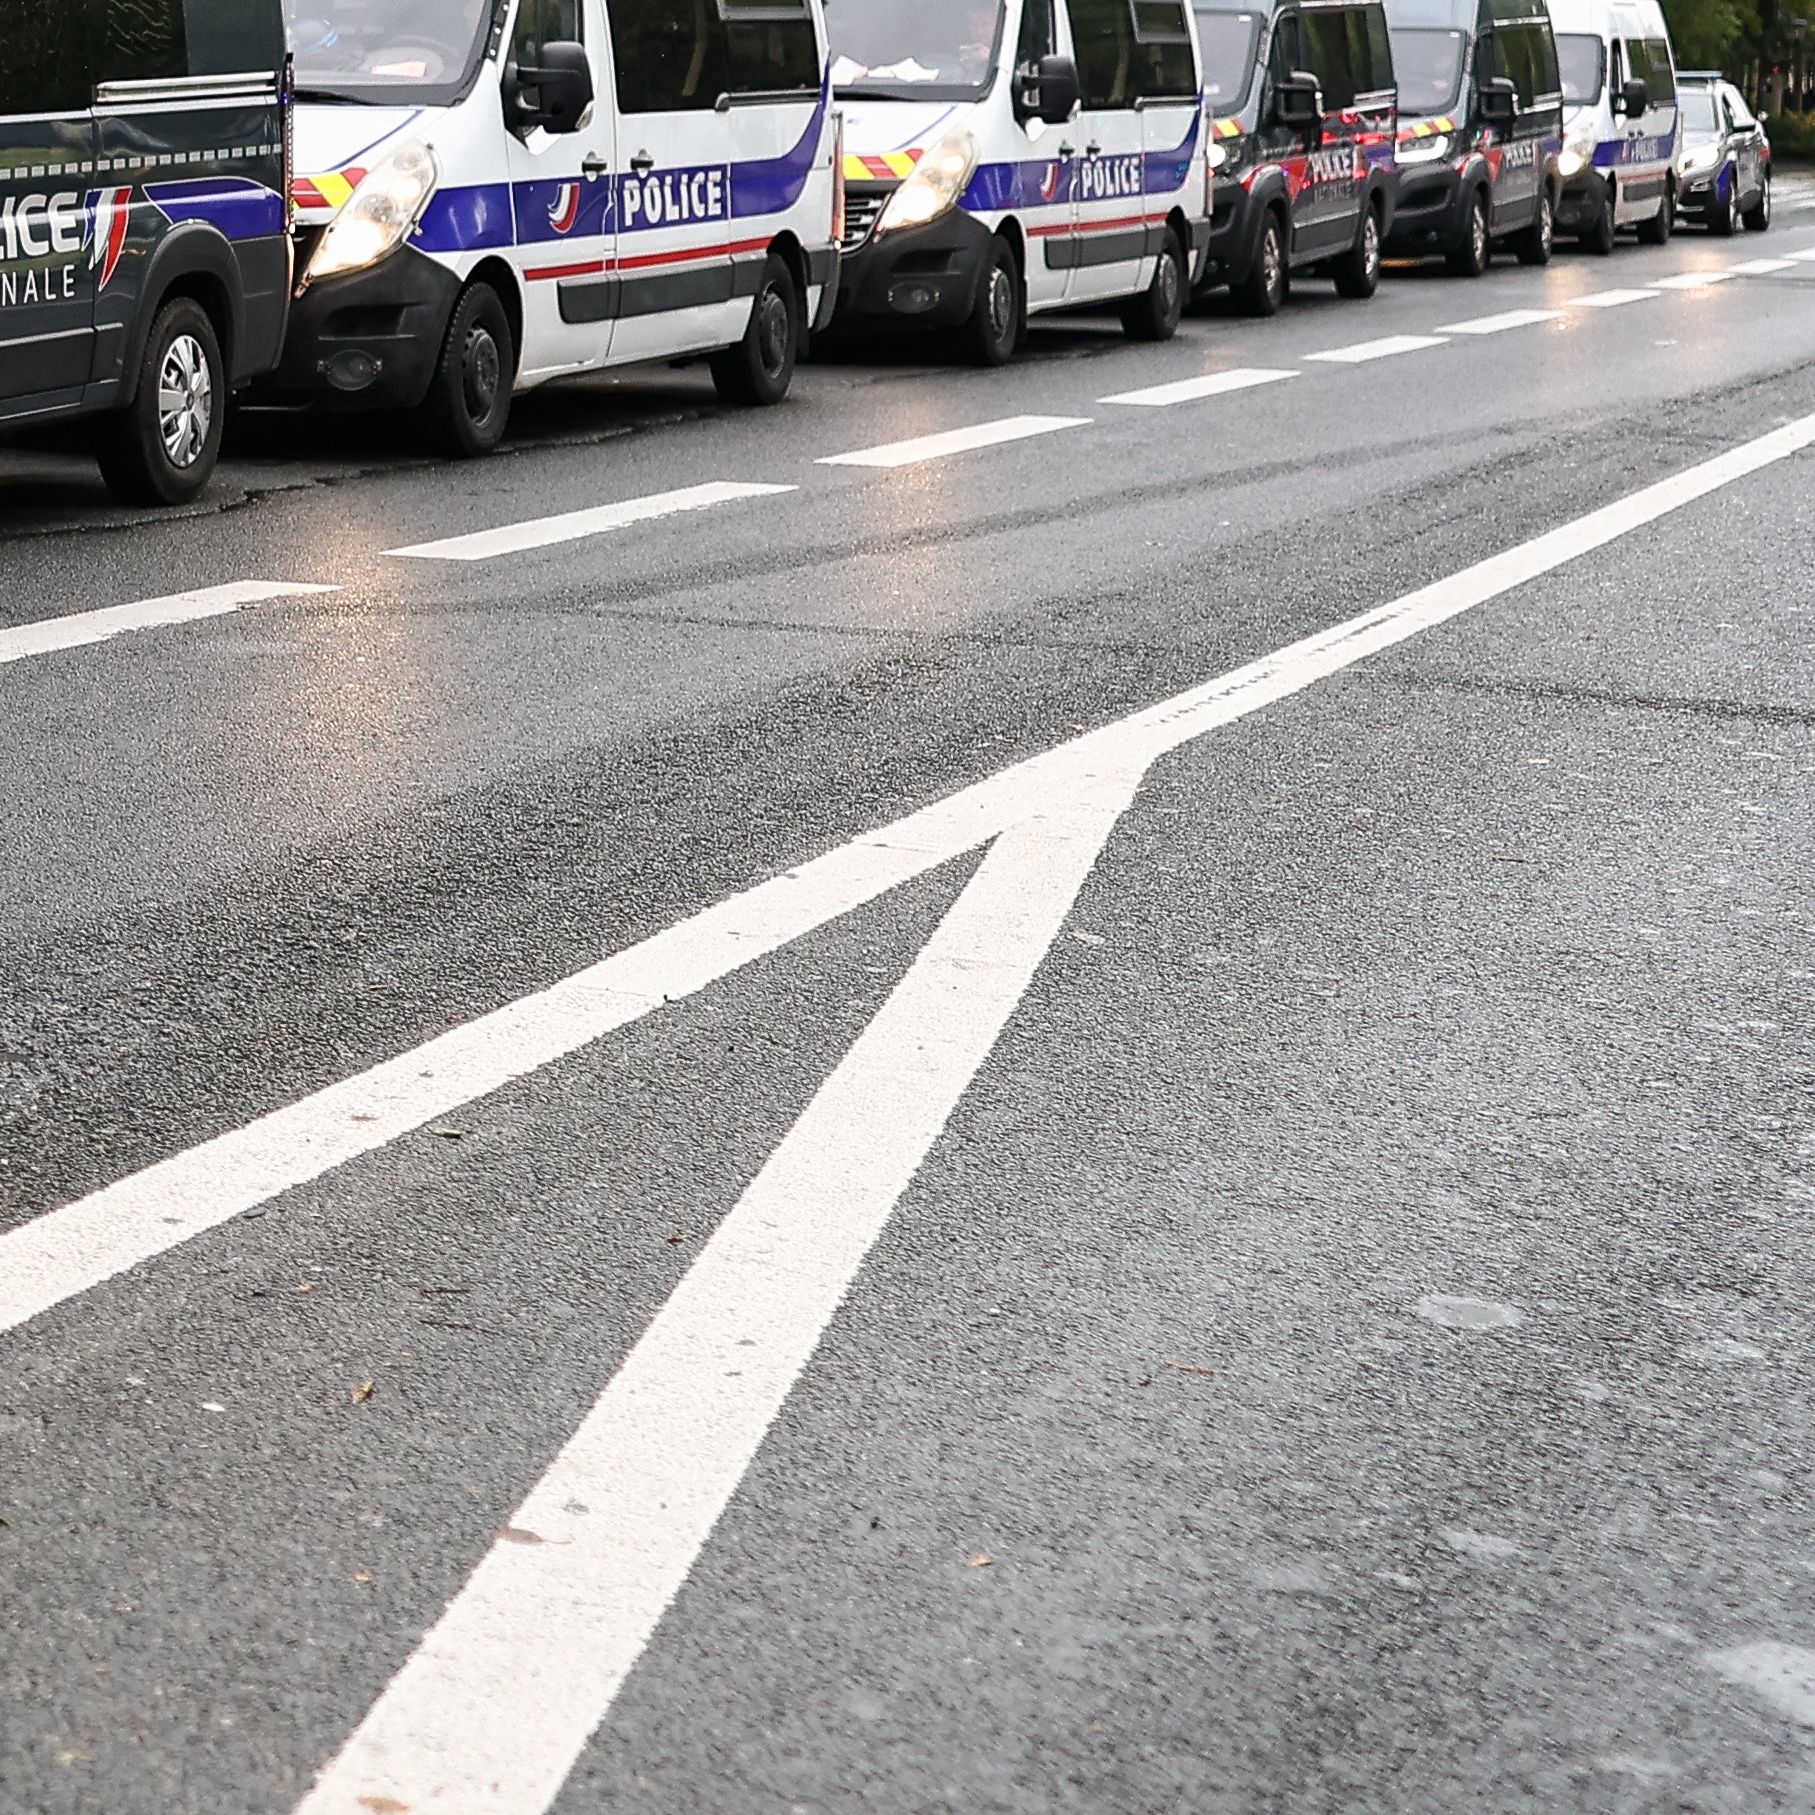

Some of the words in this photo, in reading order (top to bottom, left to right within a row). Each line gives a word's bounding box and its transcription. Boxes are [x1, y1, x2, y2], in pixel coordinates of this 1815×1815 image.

[1081, 157, 1141, 199] POLICE
[1308, 147, 1352, 184] POLICE
[622, 170, 722, 227] POLICE
